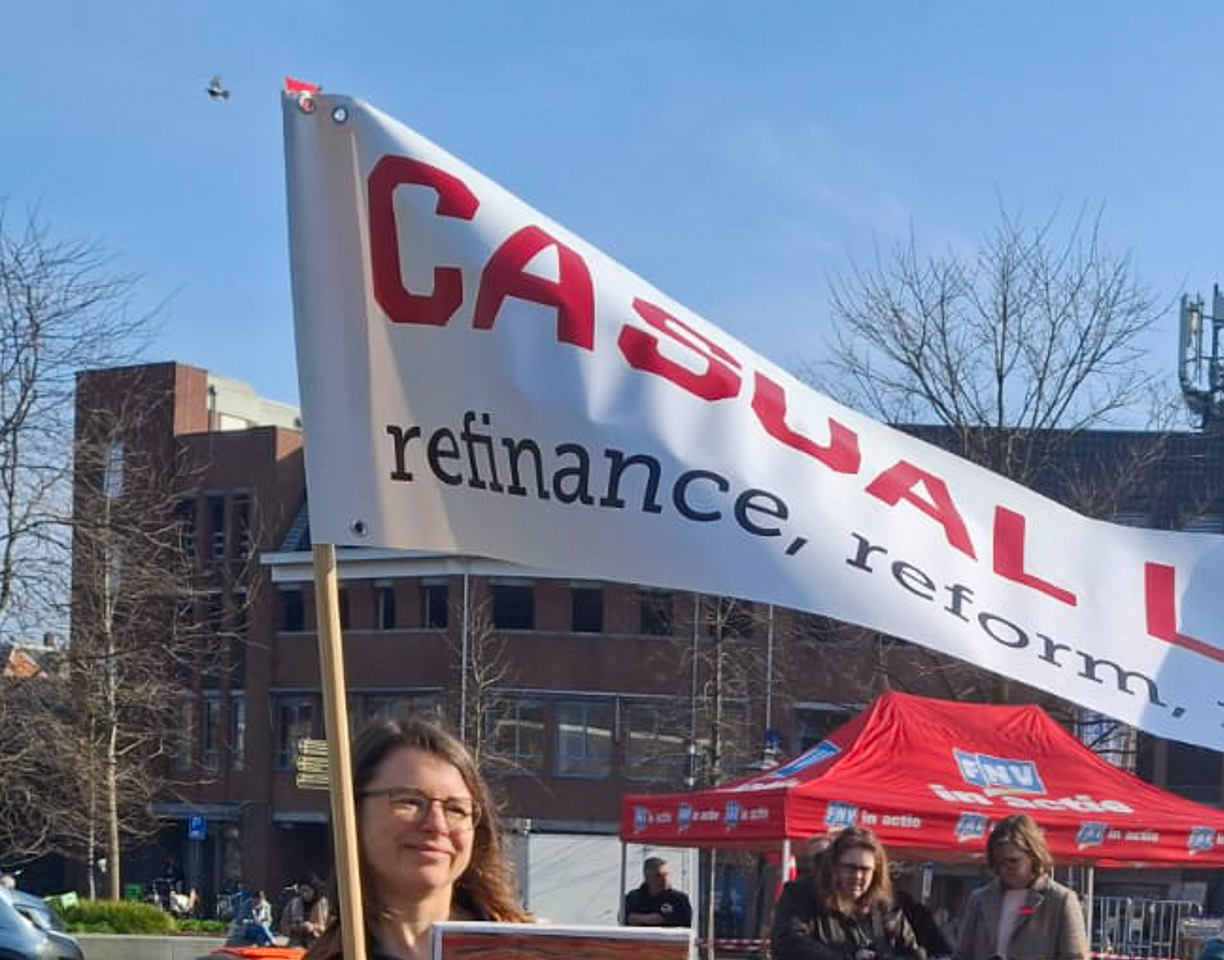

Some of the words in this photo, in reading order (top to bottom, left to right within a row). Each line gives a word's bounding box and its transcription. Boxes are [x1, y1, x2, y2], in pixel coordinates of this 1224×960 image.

[367, 154, 1077, 607] CASUAL
[386, 412, 810, 556] refinance,
[846, 531, 1188, 719] reform,
